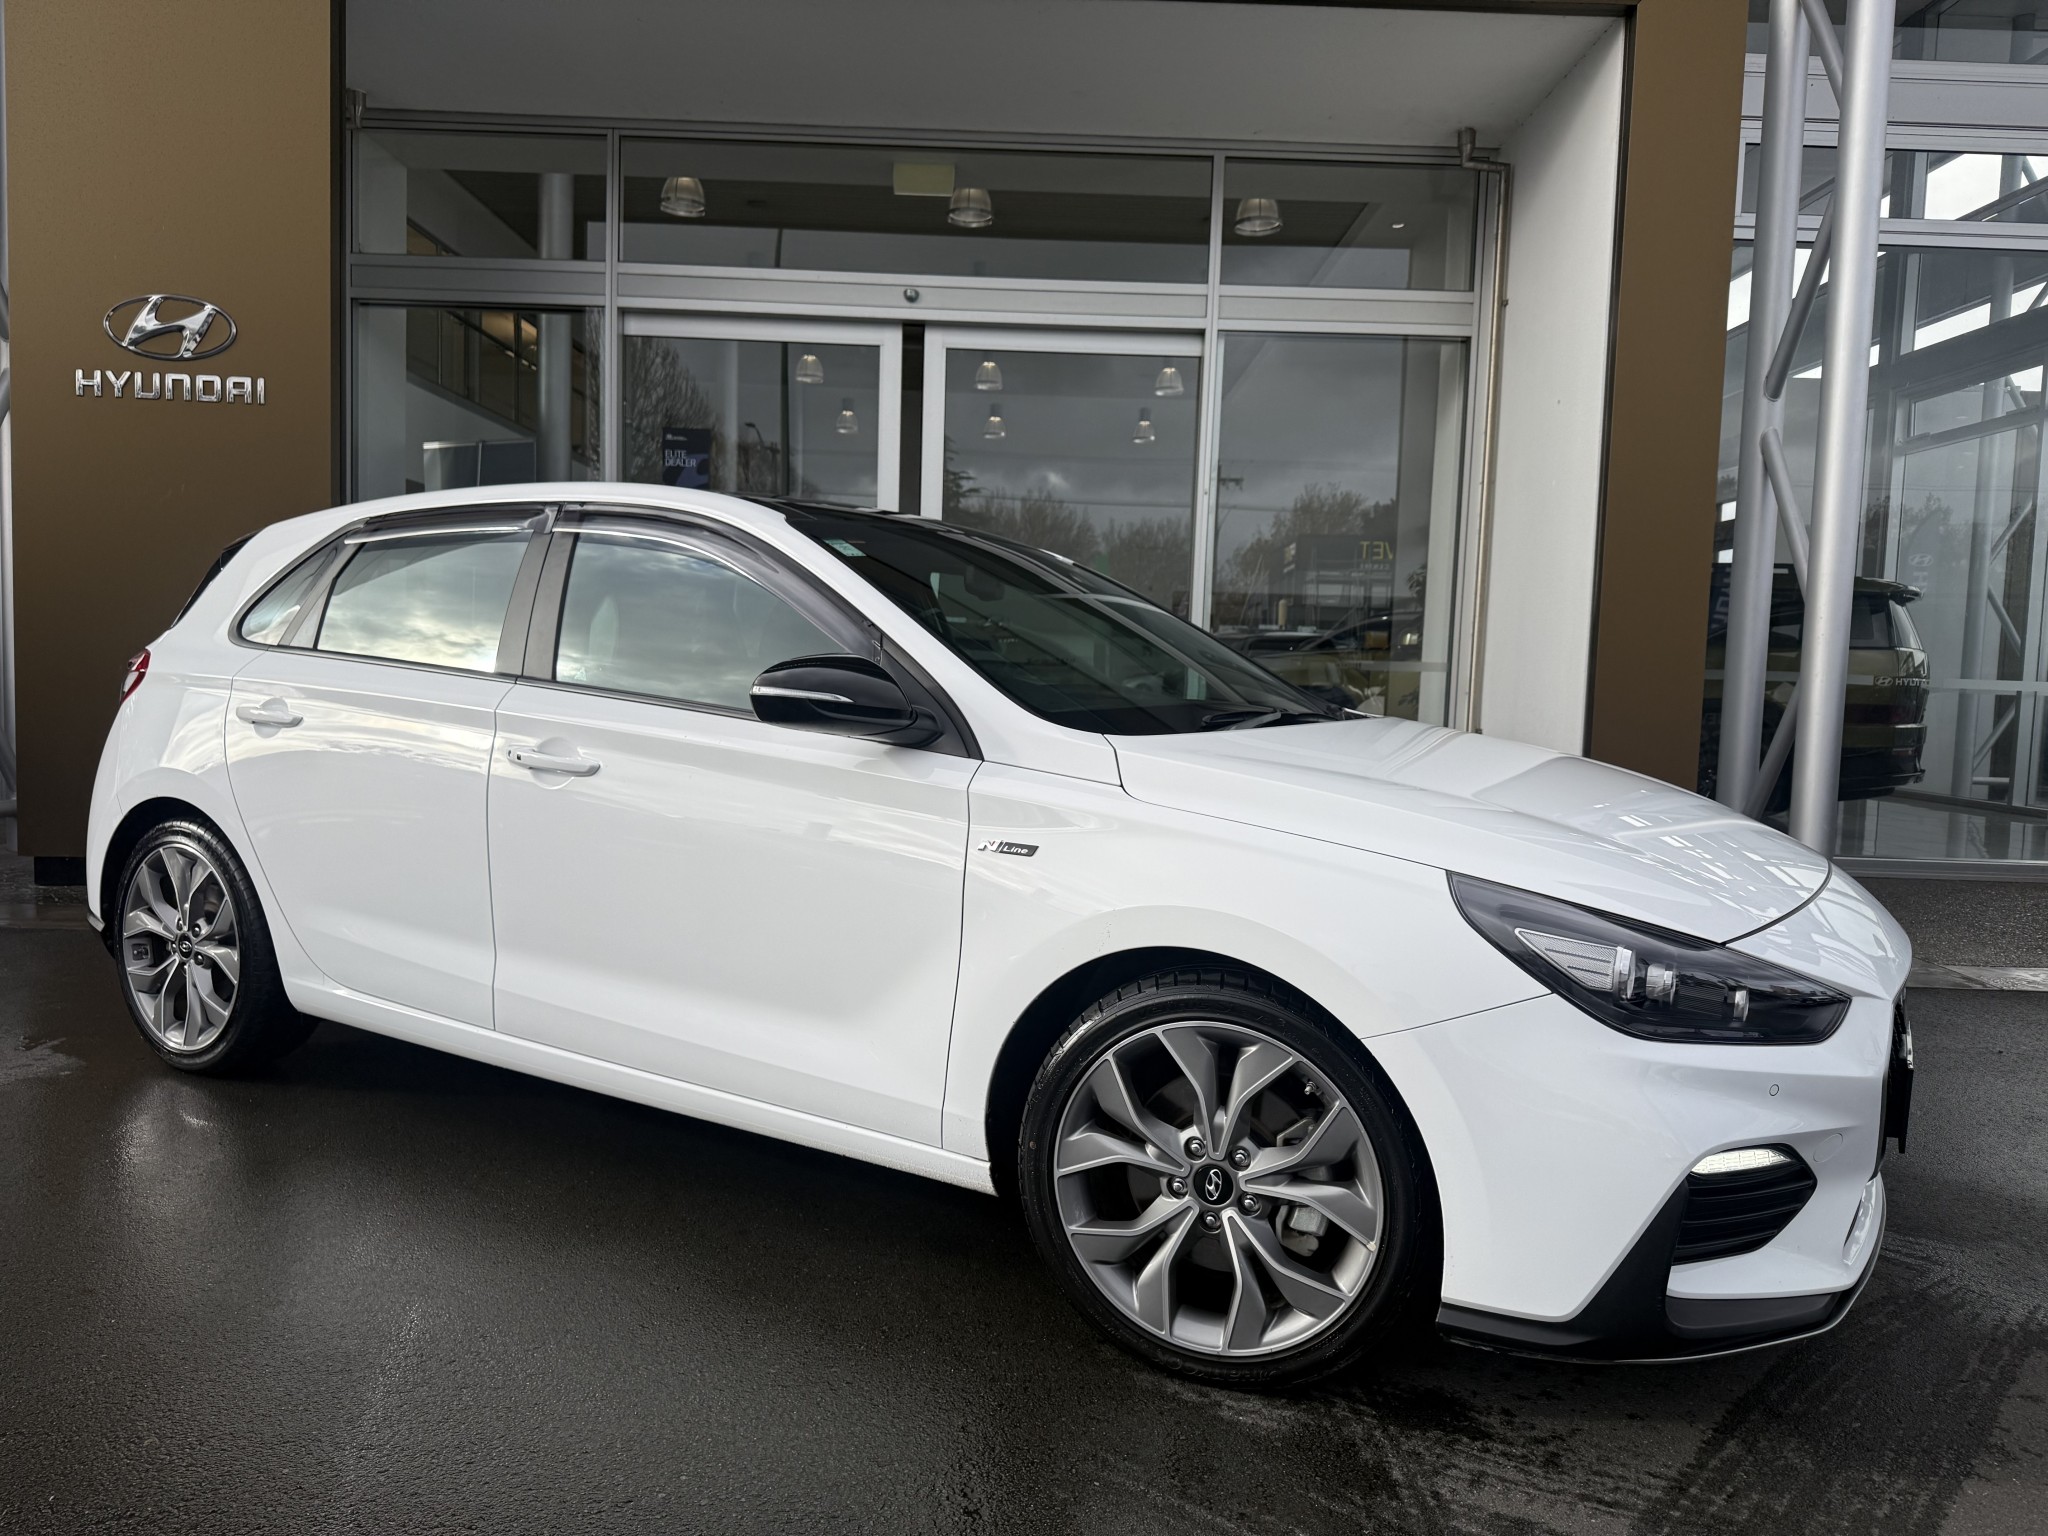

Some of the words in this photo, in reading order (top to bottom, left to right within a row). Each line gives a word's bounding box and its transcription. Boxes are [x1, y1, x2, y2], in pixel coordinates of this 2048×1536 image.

[76, 368, 265, 404] HYUNDAI
[665, 458, 697, 467] DEALER
[1003, 845, 1029, 854] Line
